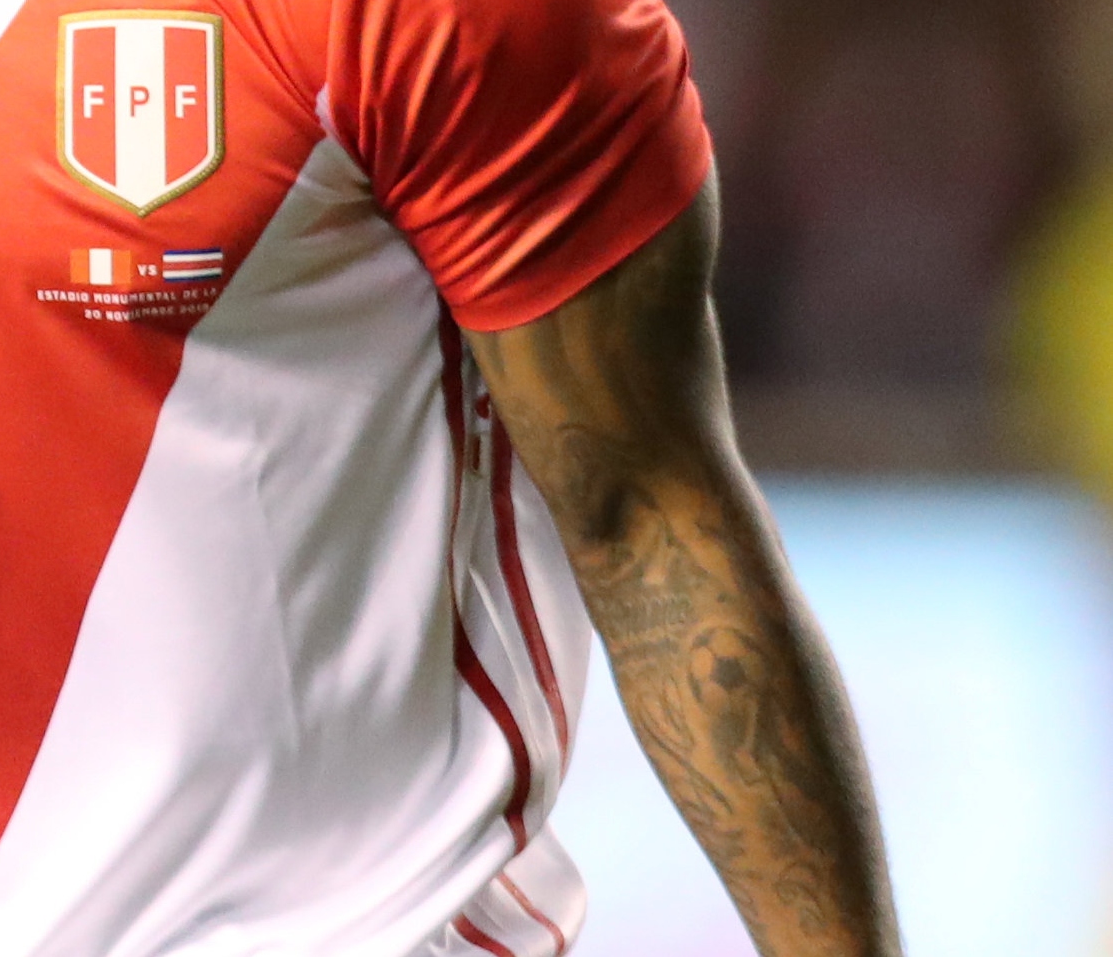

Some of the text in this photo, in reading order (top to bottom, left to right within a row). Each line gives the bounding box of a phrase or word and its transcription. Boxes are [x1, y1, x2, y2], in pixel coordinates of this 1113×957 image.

[137, 264, 158, 276] VS
[37, 290, 90, 303] ESTADIO
[93, 292, 176, 306] MONUMENTAL
[84, 308, 103, 320] 20
